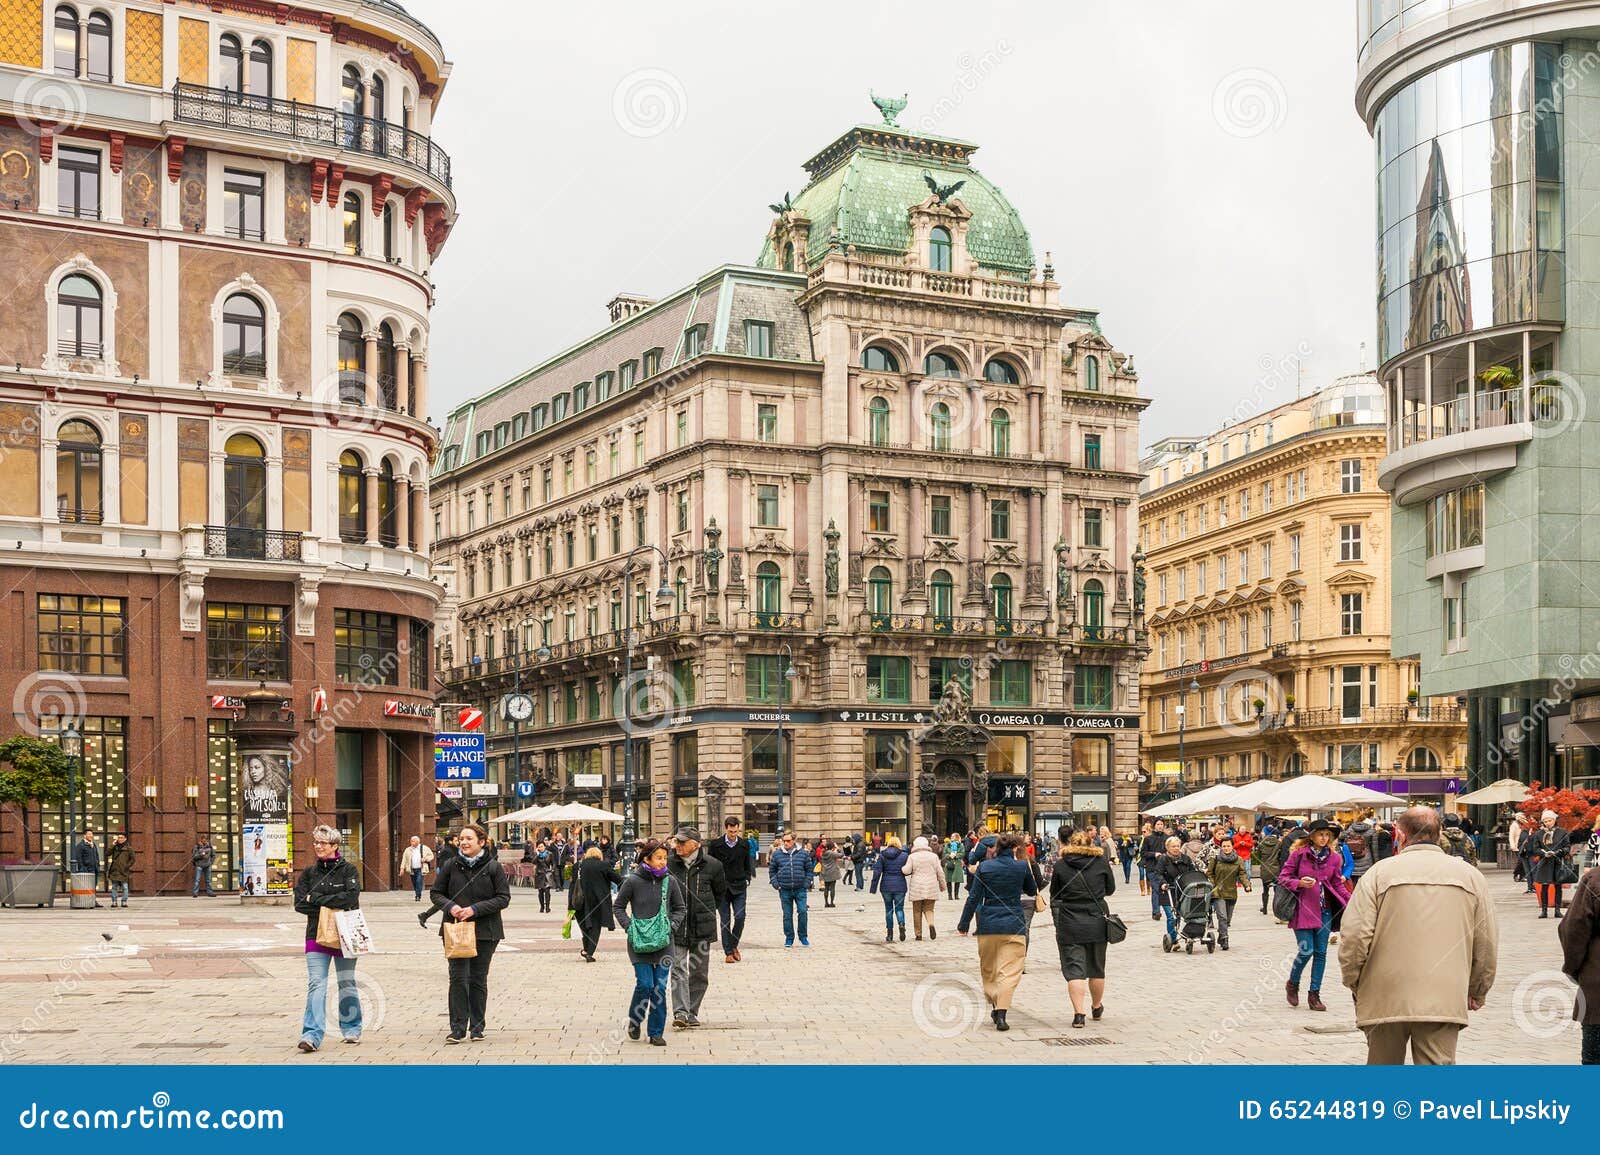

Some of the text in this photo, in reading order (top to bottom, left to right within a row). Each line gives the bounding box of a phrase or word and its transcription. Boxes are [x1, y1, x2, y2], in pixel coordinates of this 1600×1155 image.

[398, 701, 417, 716] Bank
[749, 713, 791, 722] BUCHERER
[856, 712, 909, 722] PILSTL
[993, 715, 1031, 725] OMEGA
[1076, 718, 1111, 729] OMEGA
[520, 784, 533, 796] U
[250, 800, 277, 812] WILSON
